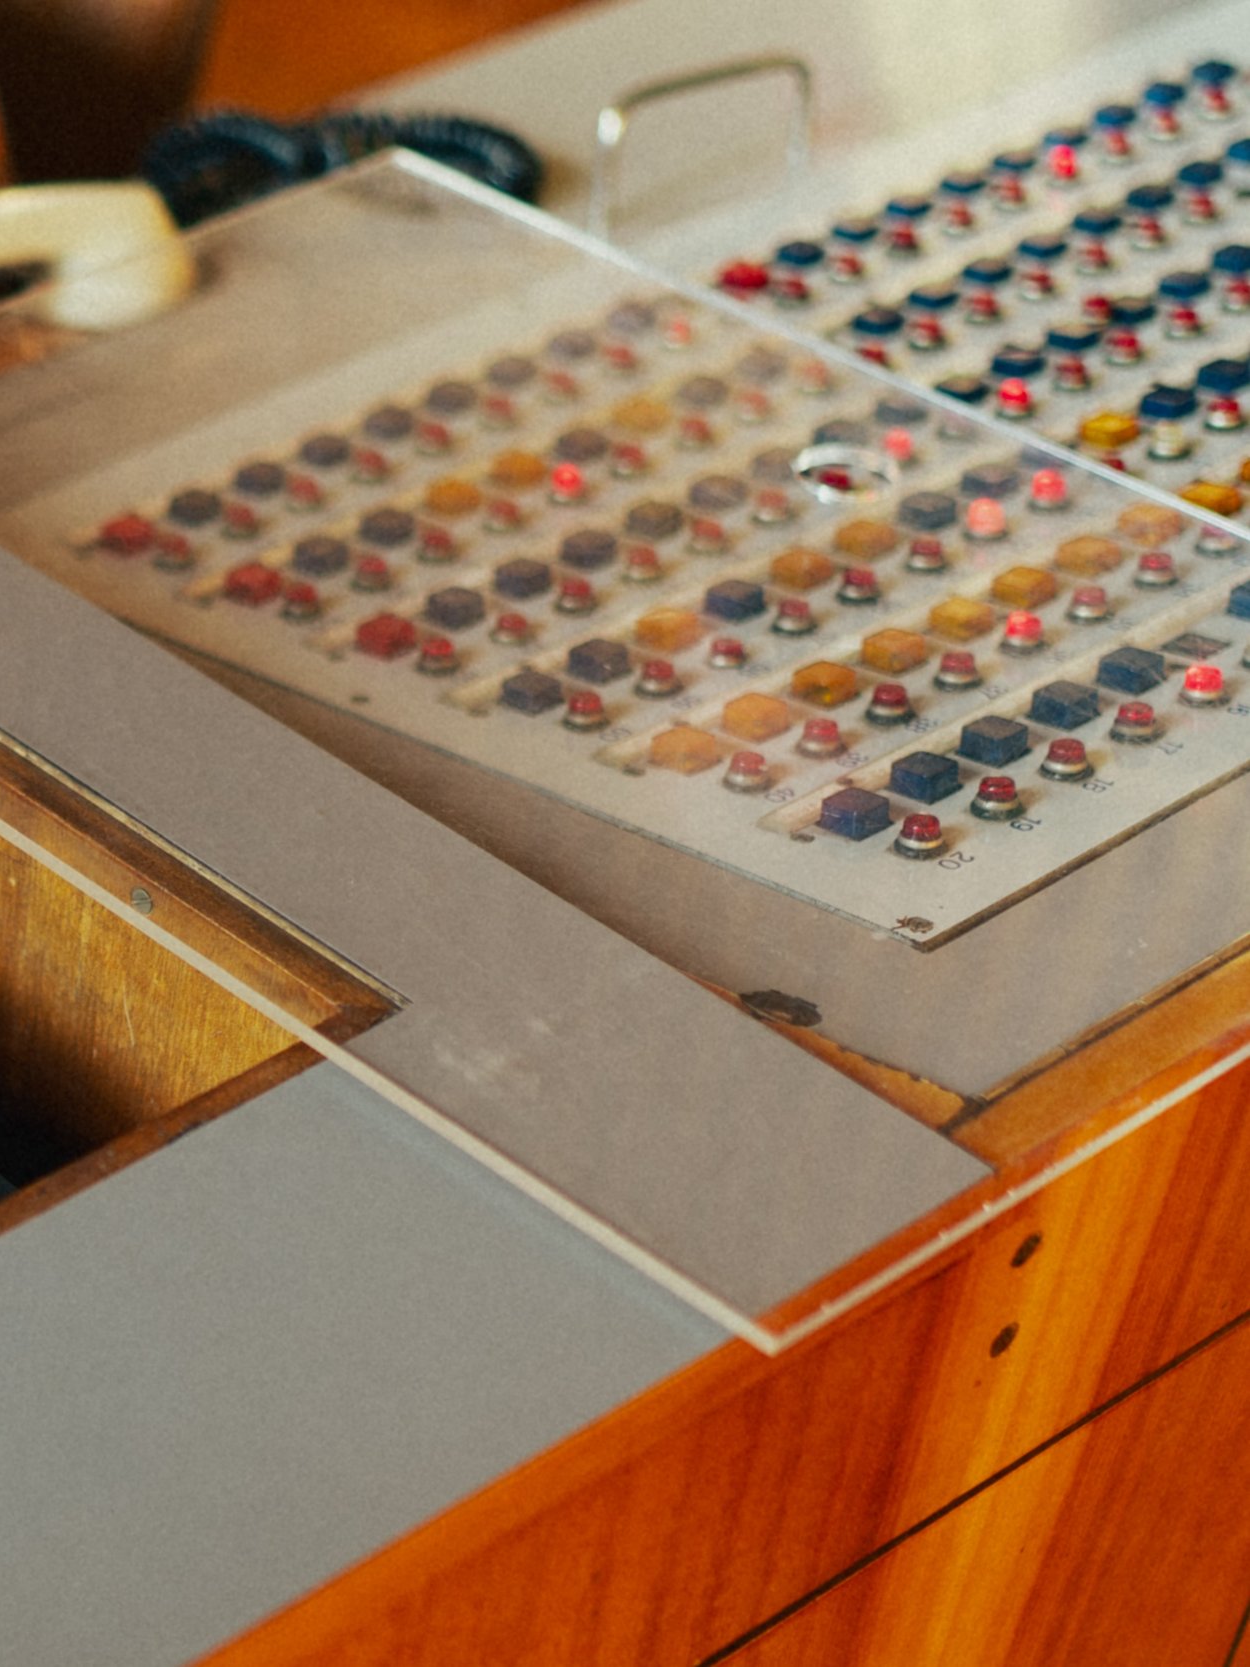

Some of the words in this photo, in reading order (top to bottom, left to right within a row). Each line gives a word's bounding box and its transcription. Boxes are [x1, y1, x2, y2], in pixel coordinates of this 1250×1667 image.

[1081, 778, 1115, 793] 18
[1010, 816, 1042, 832] 19
[938, 851, 975, 870] 20
